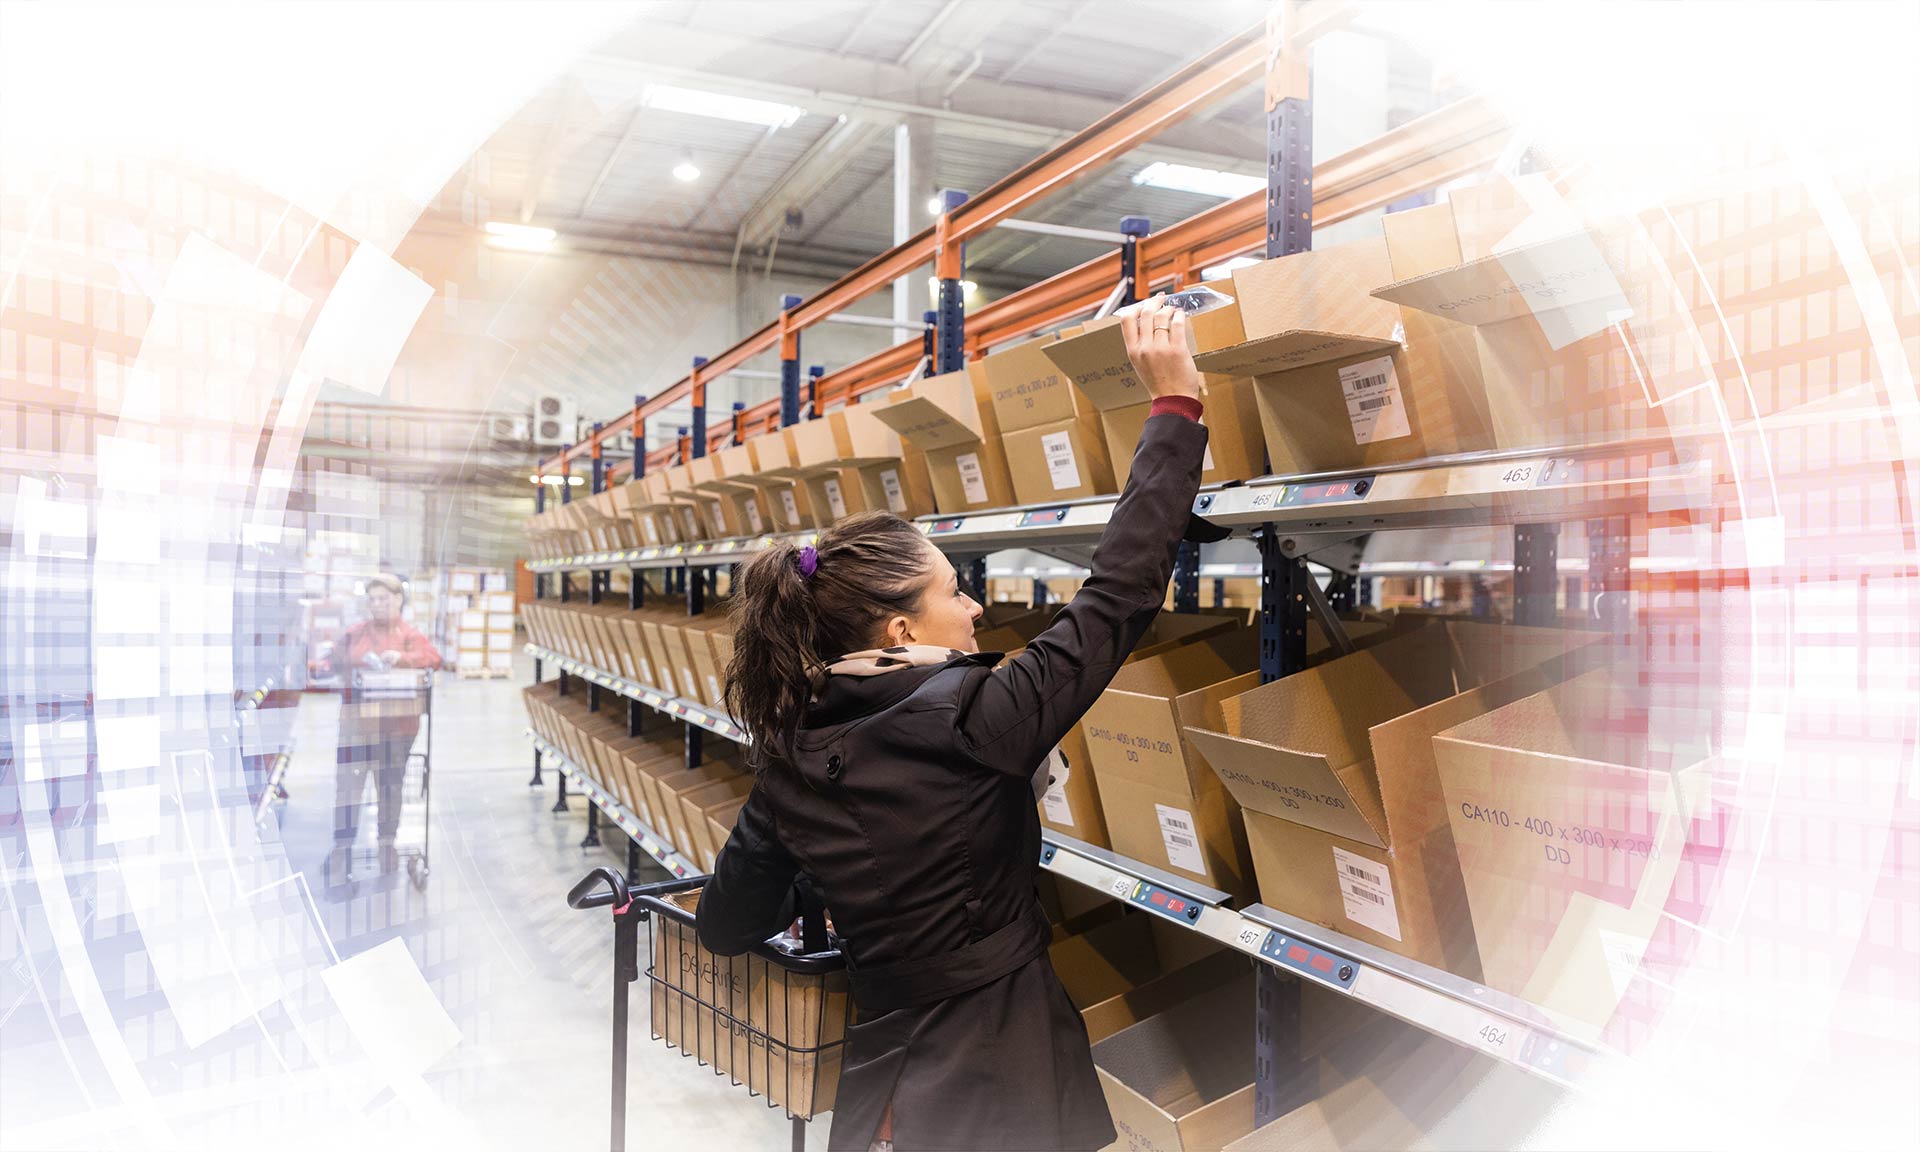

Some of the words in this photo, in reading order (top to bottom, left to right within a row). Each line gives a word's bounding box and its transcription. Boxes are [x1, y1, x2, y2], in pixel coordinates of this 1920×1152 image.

[1438, 293, 1491, 311] CA110
[1120, 377, 1136, 388] DD
[1024, 397, 1034, 408] DD
[1502, 467, 1531, 482] 463
[1090, 726, 1112, 741] CA110
[1117, 733, 1129, 745] 400
[1136, 736, 1150, 750] 300
[1157, 740, 1173, 754] 200
[1126, 750, 1138, 762] DD
[1221, 768, 1255, 786] CA110
[1261, 779, 1281, 793] 400
[1289, 786, 1312, 801] 300
[1320, 794, 1345, 810] 200
[1280, 796, 1299, 810] DD
[1461, 802, 1510, 828] CA110
[1524, 816, 1554, 838] 400
[1559, 827, 1569, 841] x
[1572, 826, 1605, 849] 300
[1609, 838, 1622, 853] x
[1624, 838, 1661, 861] 200
[1544, 844, 1571, 865] DD
[1240, 929, 1259, 945] 467
[1479, 1024, 1507, 1046] 464
